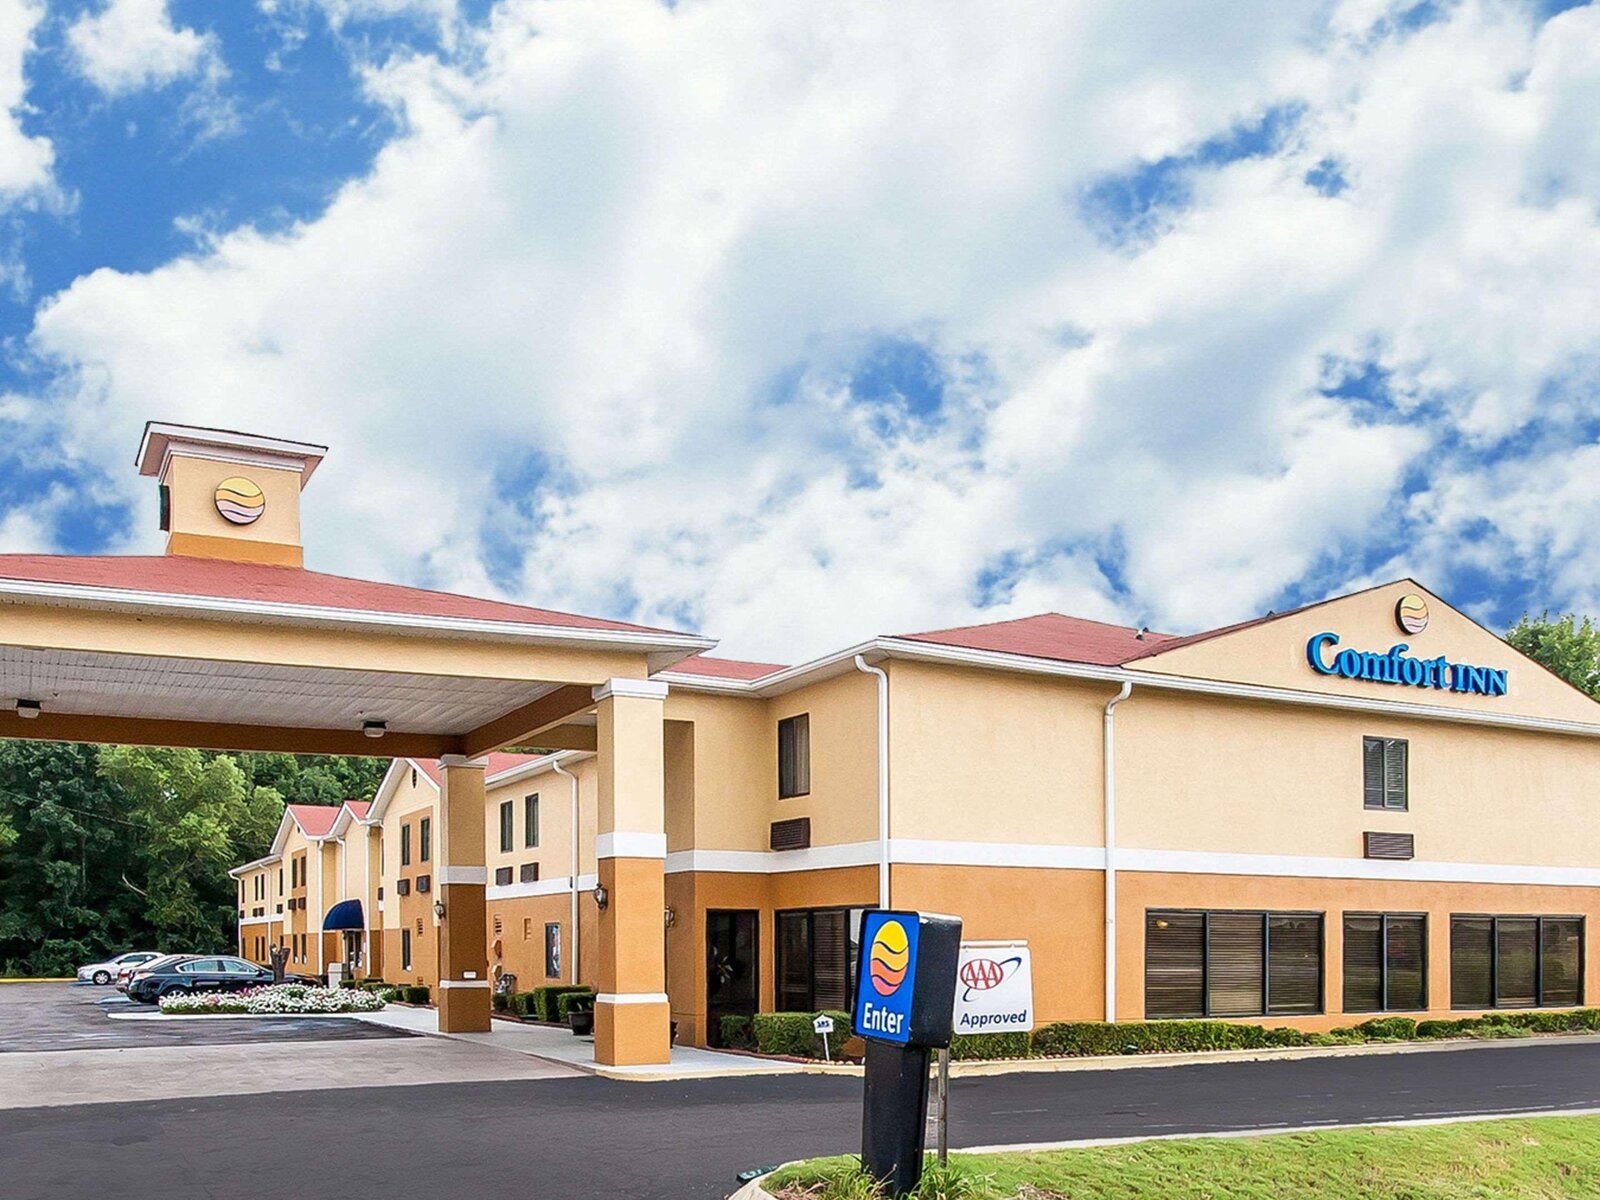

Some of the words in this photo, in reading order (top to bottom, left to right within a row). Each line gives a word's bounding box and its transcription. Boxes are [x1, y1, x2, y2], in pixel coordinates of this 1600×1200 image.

[1307, 633, 1451, 689] Comfort
[1451, 665, 1508, 695] INN
[964, 960, 1000, 990] AAA
[863, 1003, 904, 1034] Enter
[960, 1010, 1027, 1028] Approved
